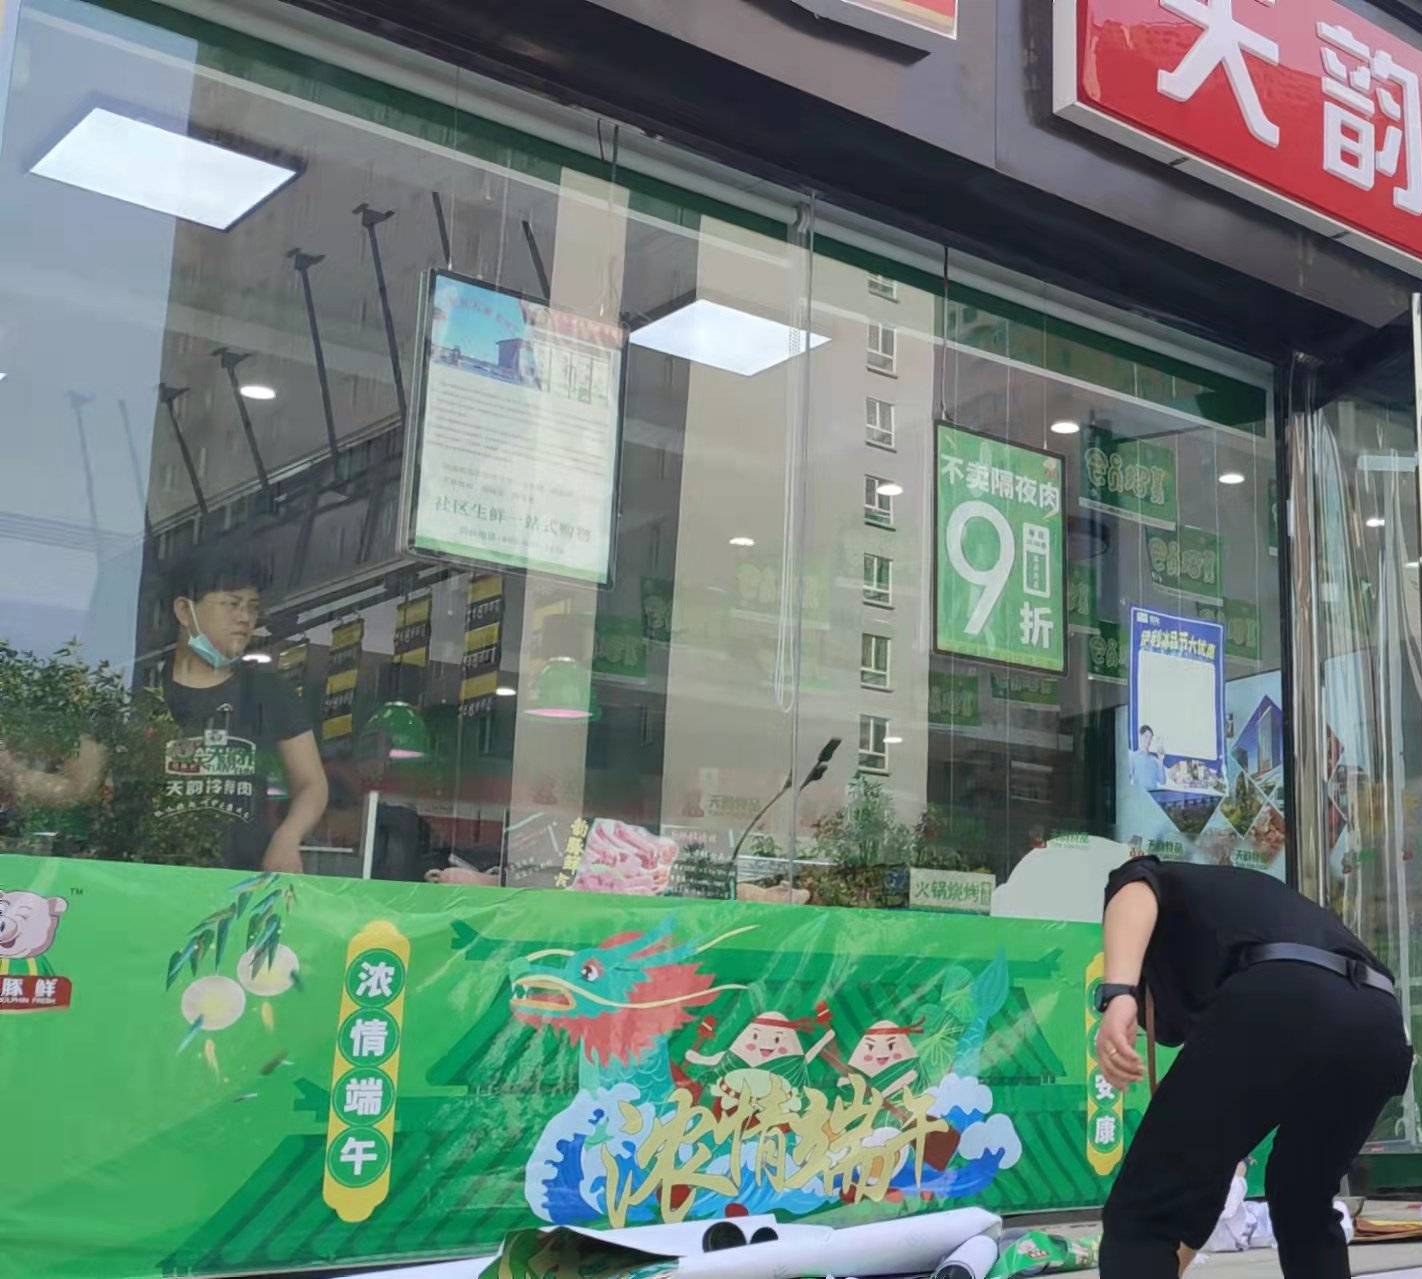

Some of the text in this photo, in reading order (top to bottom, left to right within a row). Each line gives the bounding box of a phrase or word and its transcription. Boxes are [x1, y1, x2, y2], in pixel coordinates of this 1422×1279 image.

[940, 454, 1060, 513] 不卖隔夜肉
[339, 961, 395, 1176] 浓情端午
[604, 1074, 952, 1228] 浓情端午
